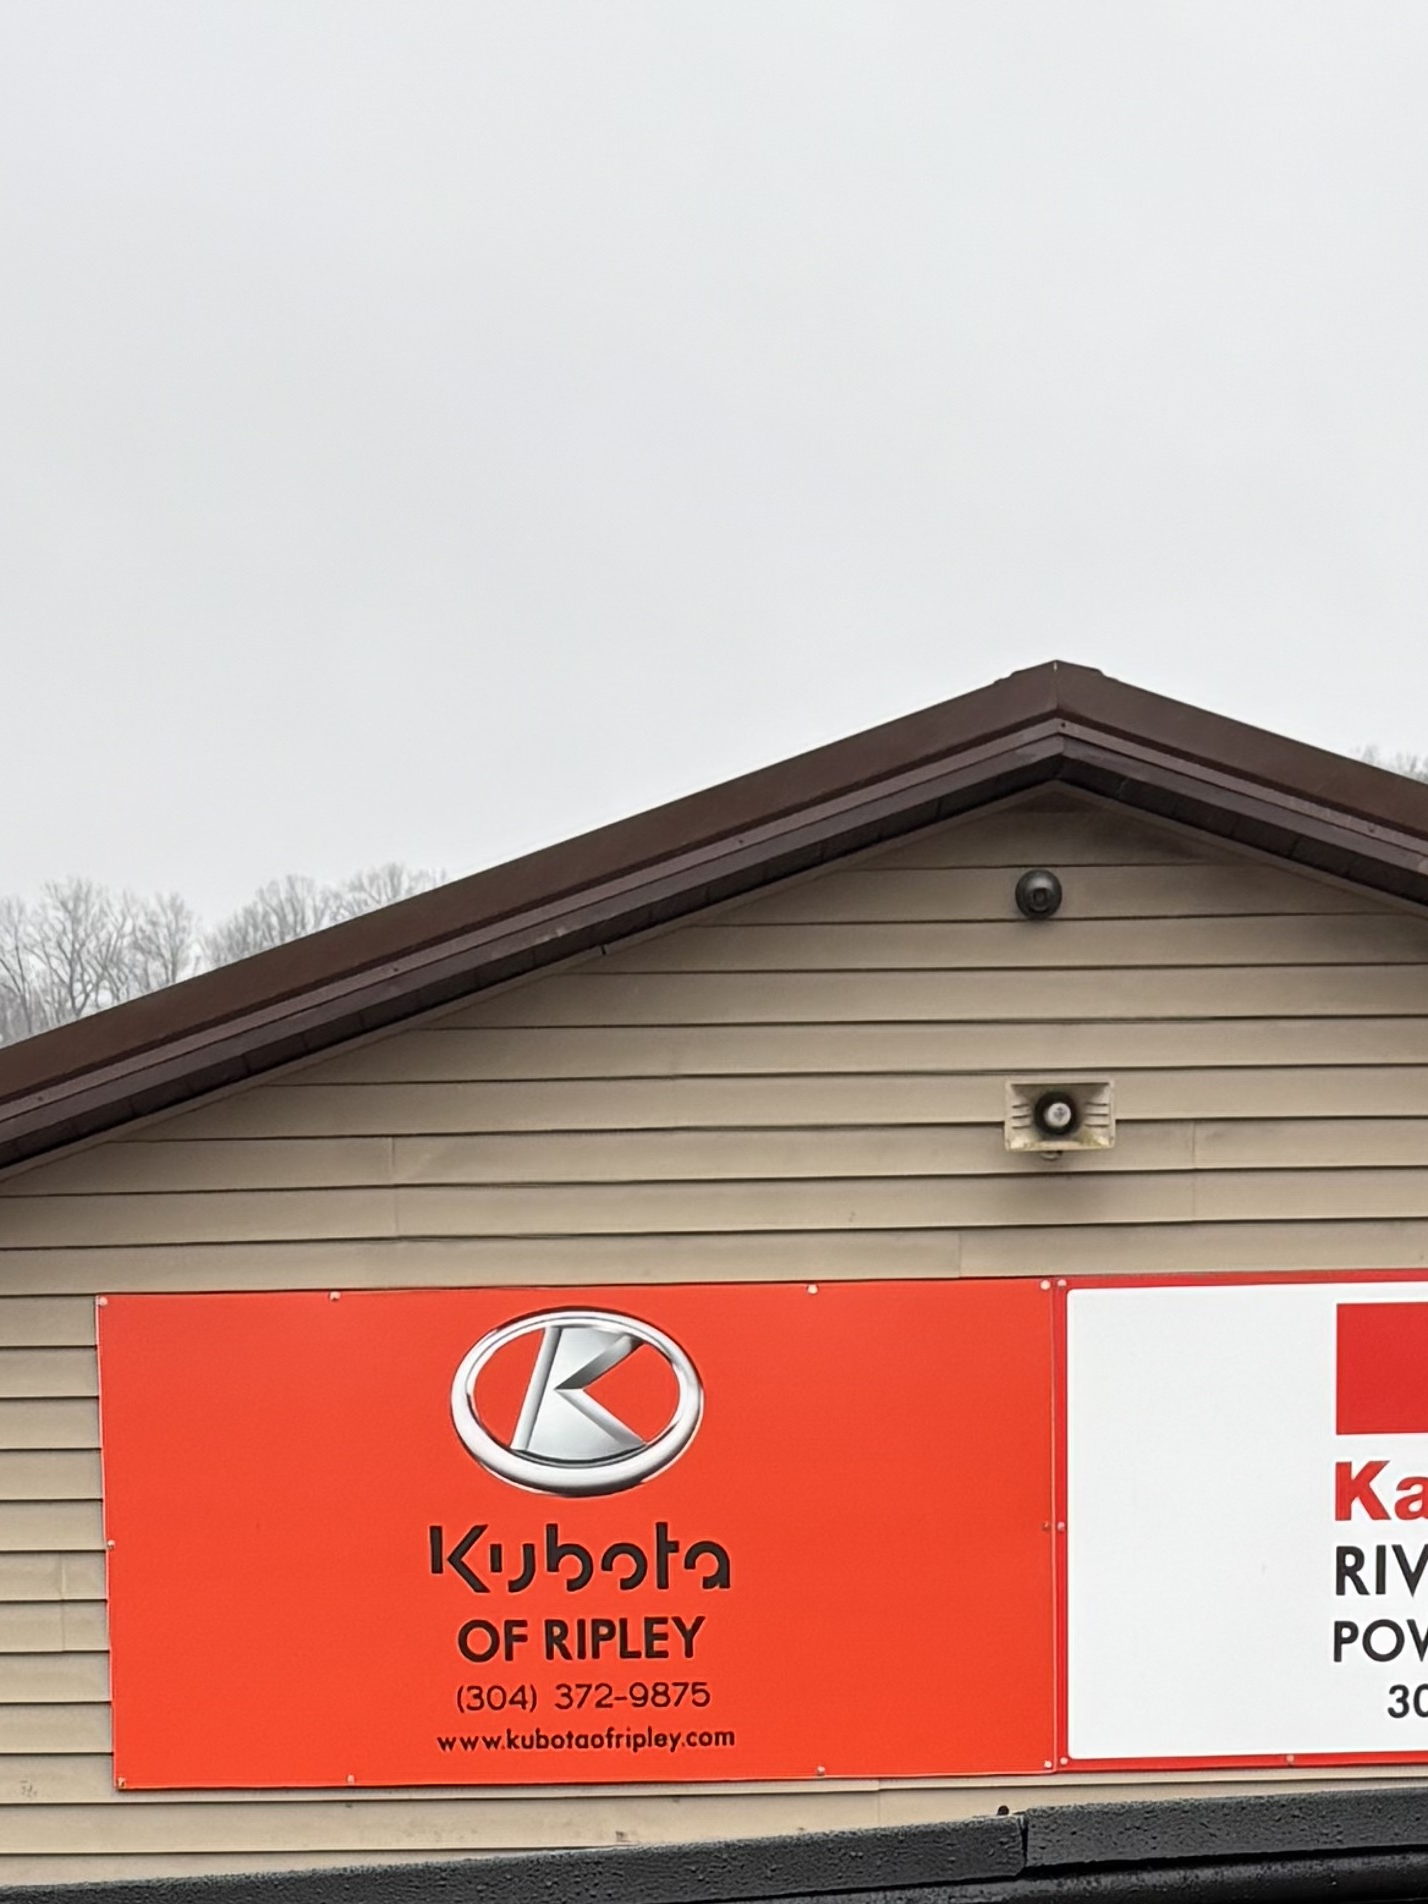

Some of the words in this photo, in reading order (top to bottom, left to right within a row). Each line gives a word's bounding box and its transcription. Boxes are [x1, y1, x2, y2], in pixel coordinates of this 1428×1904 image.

[429, 1521, 732, 1595] Kubota
[457, 1619, 527, 1663] OF
[545, 1616, 706, 1661] RIPLEY
[456, 1684, 538, 1714] (304)
[554, 1681, 712, 1710] 372-9875
[436, 1726, 736, 1757] www.kubotaofripley.com
